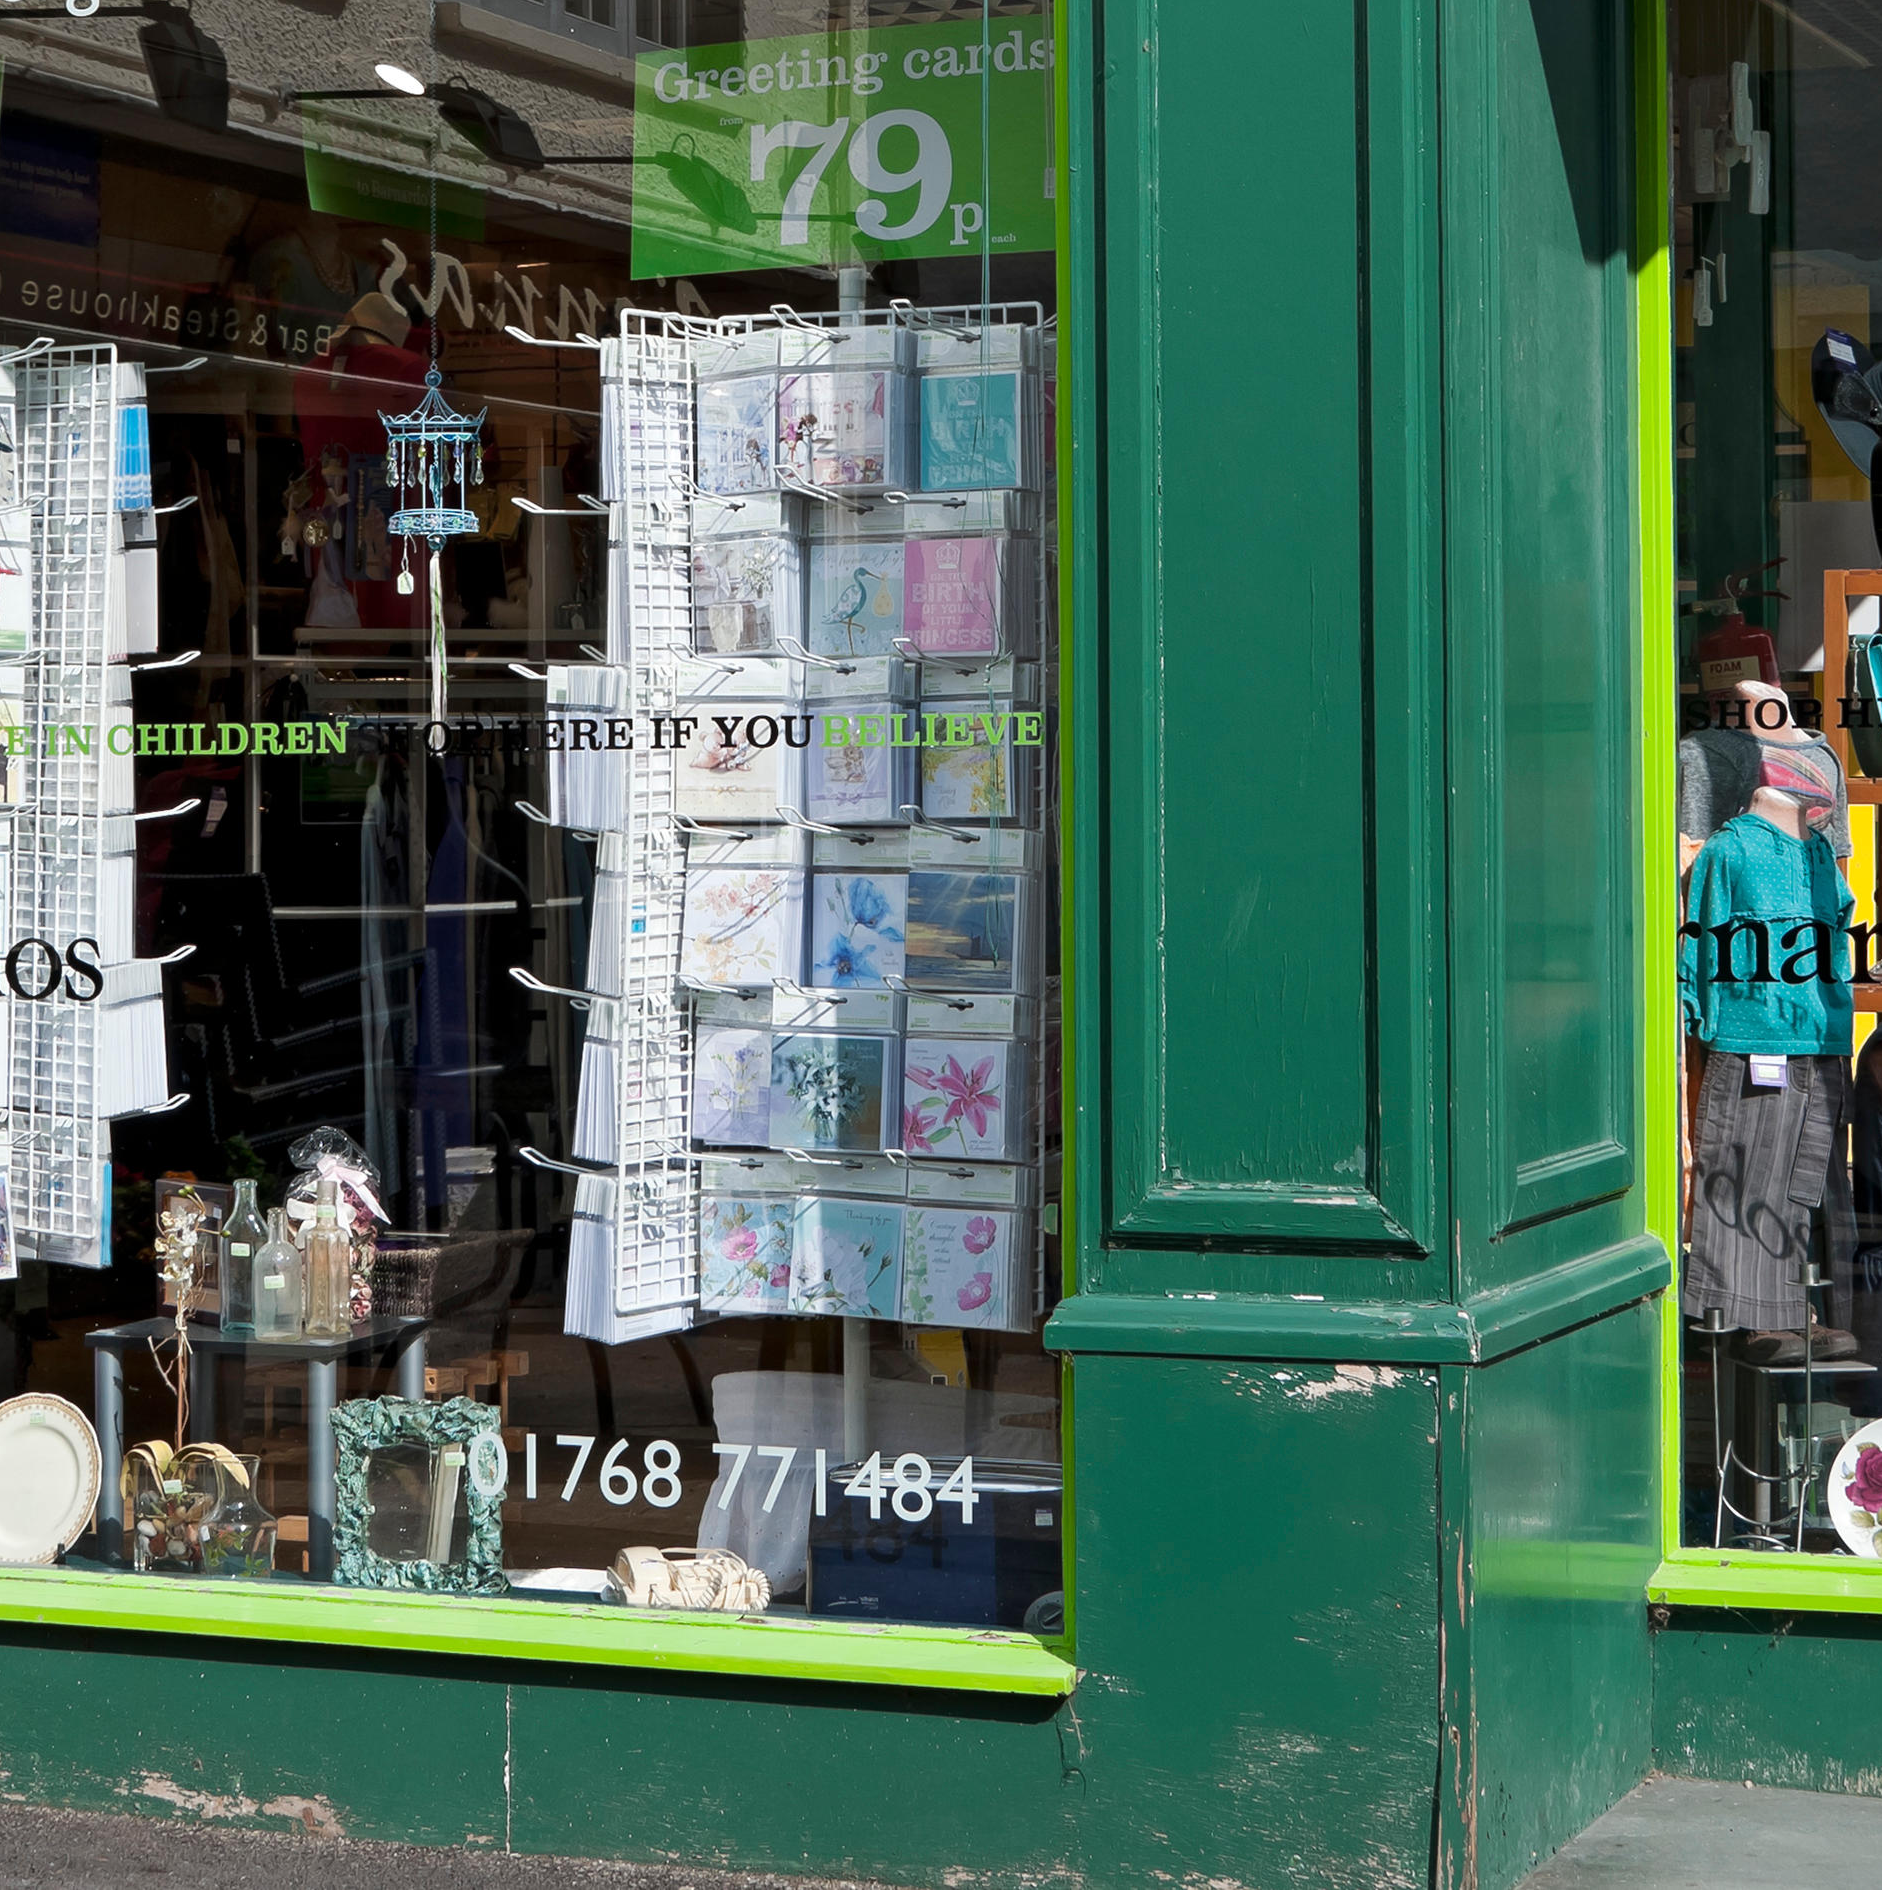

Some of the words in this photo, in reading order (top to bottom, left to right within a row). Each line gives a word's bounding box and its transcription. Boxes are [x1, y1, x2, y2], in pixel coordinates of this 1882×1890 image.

[653, 46, 888, 105] Greeting
[903, 29, 1056, 82] cards
[1709, 660, 1743, 675] FOAM
[44, 724, 96, 758] IN
[106, 720, 350, 758] CHILDREN
[498, 718, 634, 753] HERE
[649, 716, 699, 752] IF
[711, 714, 815, 750] YOU
[820, 710, 1046, 748] BELIEVE
[1686, 698, 1824, 731] SHOP
[468, 1429, 683, 1510] 01768
[711, 1442, 981, 1526] 771484
